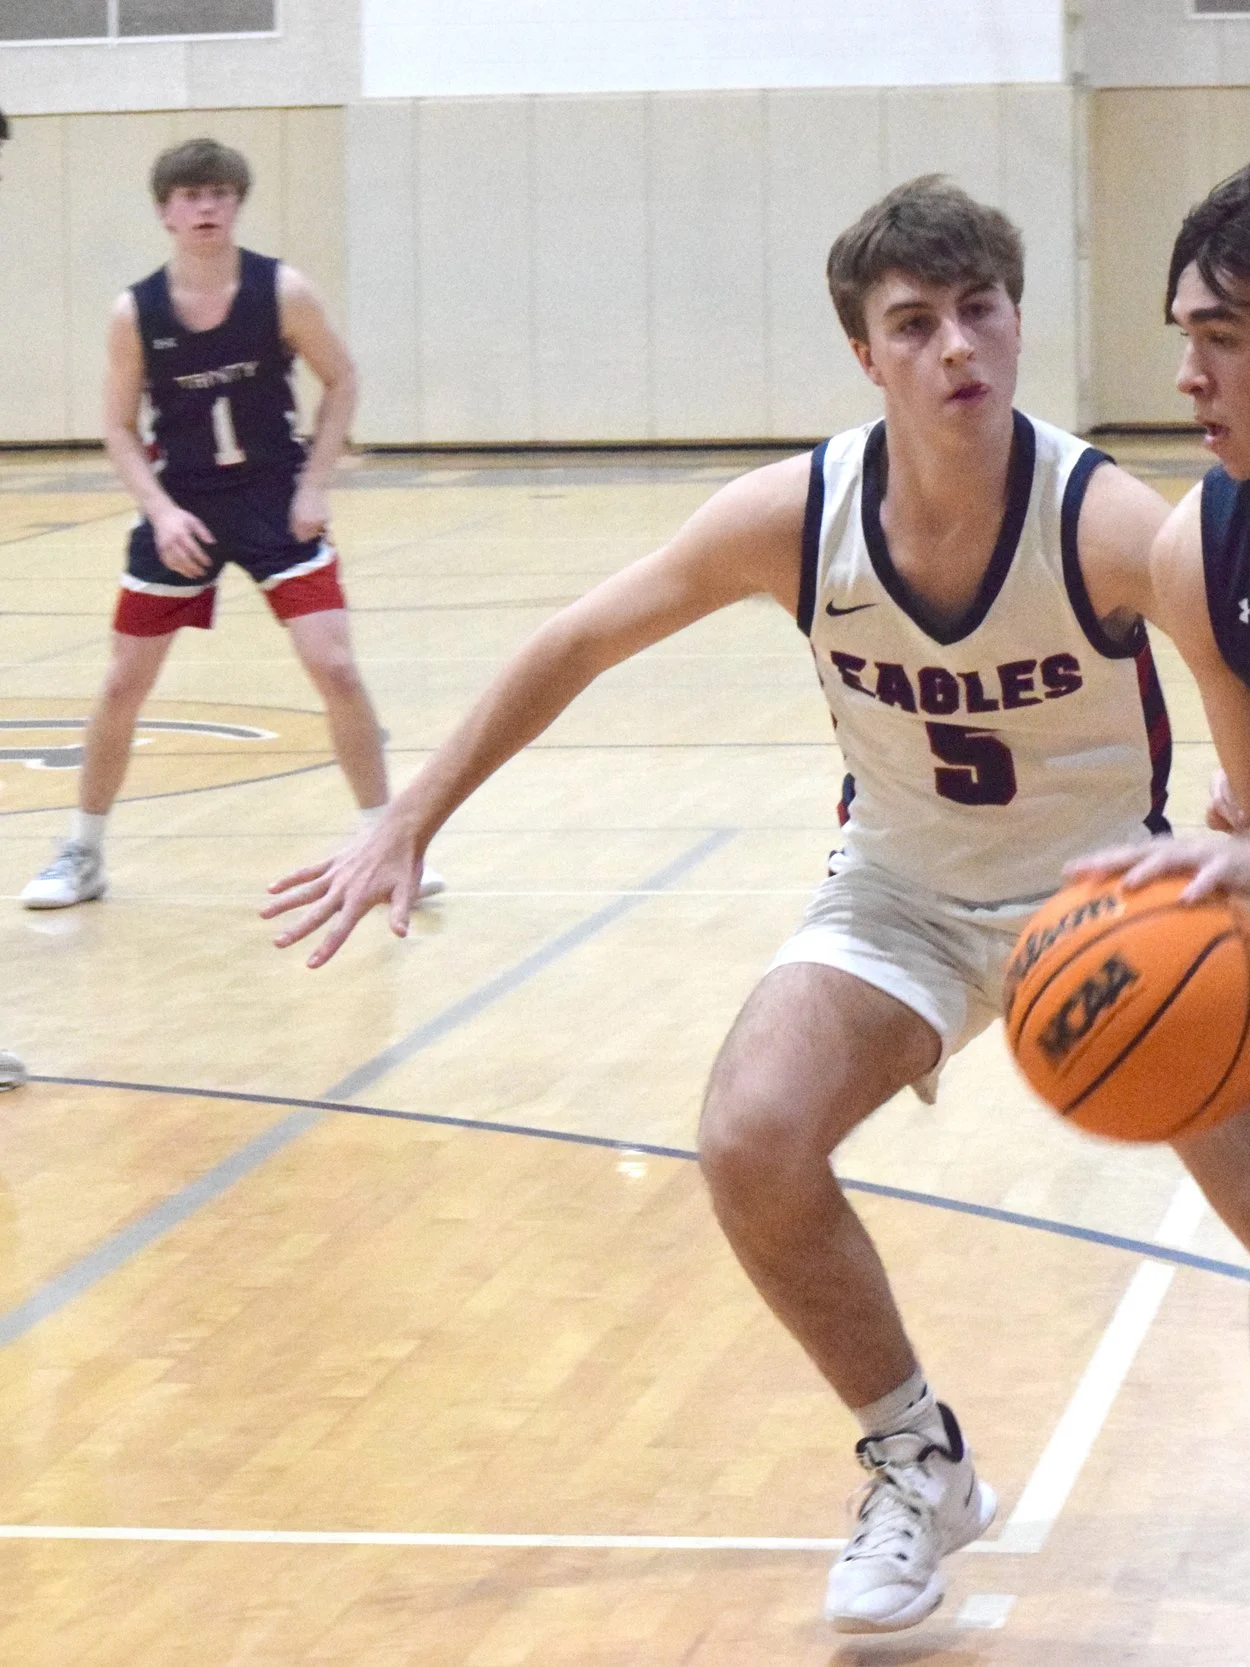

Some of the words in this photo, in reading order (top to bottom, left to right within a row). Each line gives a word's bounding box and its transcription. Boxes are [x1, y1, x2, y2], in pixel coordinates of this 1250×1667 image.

[211, 396, 247, 466] 1
[830, 651, 1083, 715] EAGLES
[925, 721, 1017, 806] 5
[1036, 954, 1137, 1064] NCAA
